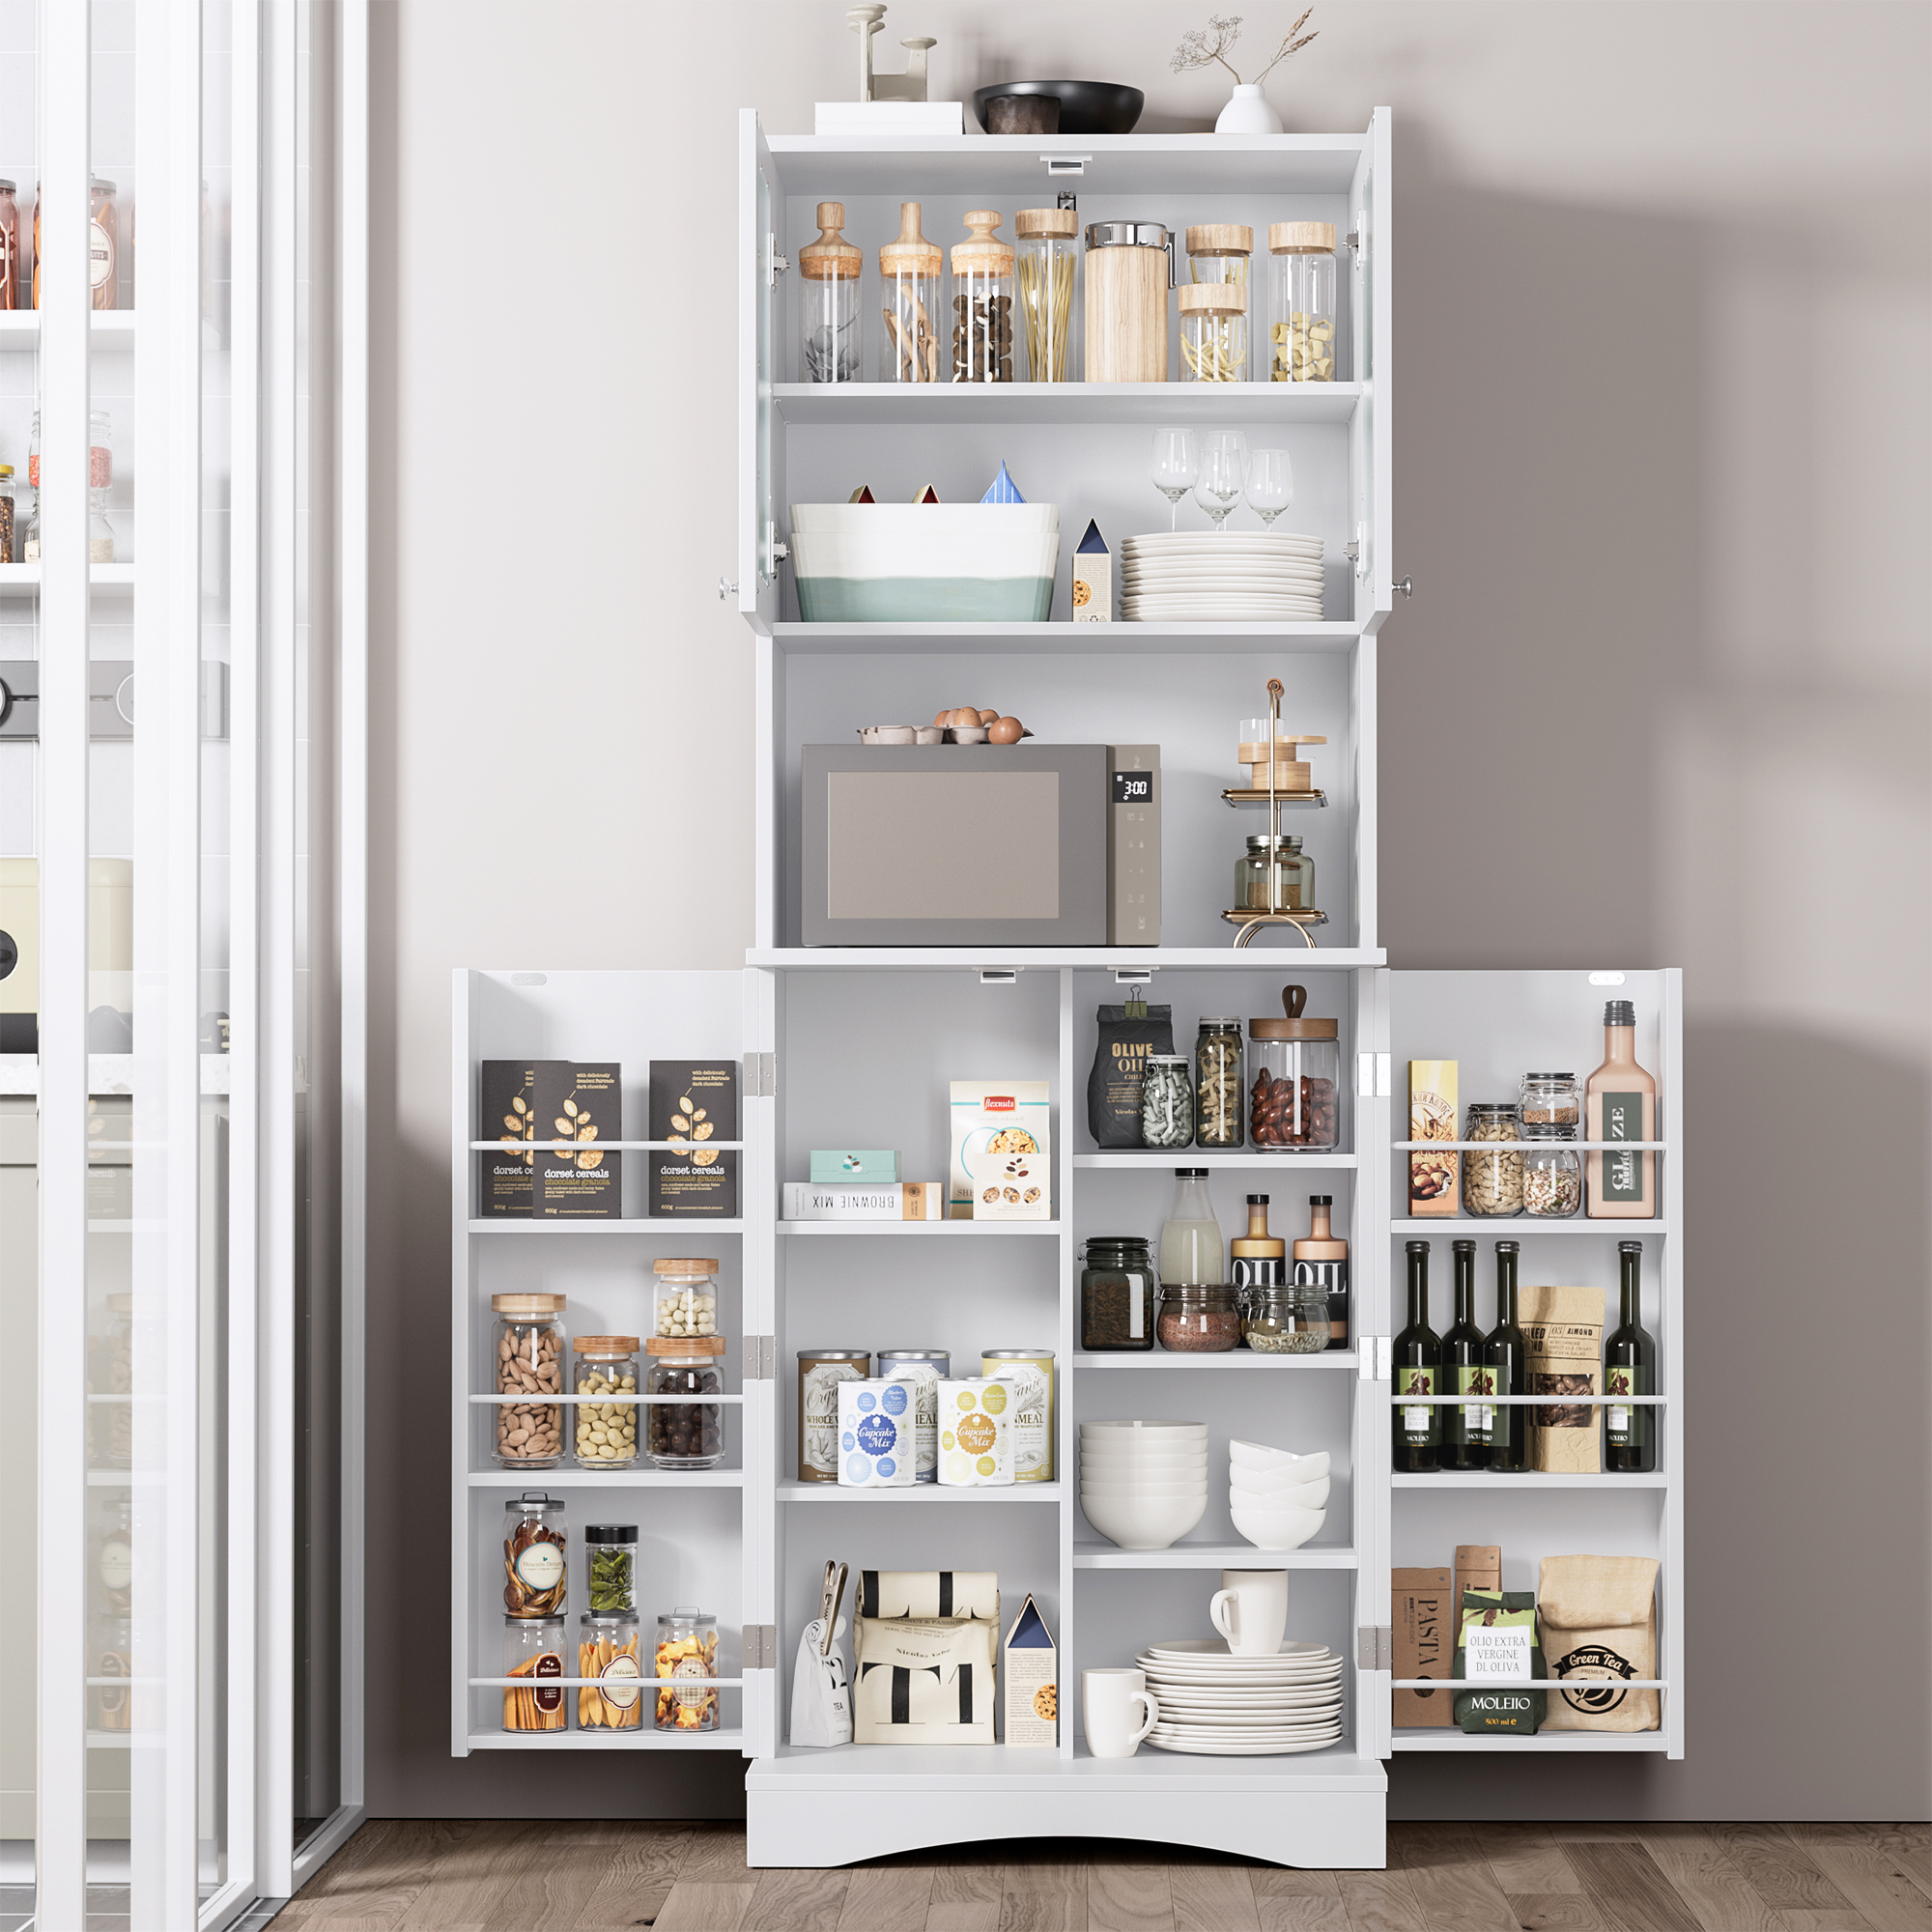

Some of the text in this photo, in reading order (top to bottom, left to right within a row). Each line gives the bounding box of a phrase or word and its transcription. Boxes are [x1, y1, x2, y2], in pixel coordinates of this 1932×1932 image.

[1125, 781, 1147, 795] 3:00
[1112, 1042, 1153, 1057] OLIVE
[1118, 1059, 1146, 1072] OIL
[984, 1098, 1014, 1109] flexnuts
[494, 1166, 523, 1175] dorset
[545, 1169, 610, 1179] dorset cereals
[661, 1166, 724, 1175] dorset cereals
[582, 1178, 611, 1186] granola
[661, 1174, 725, 1183] chocolate granola
[812, 1196, 895, 1208] BROWNIE MIX
[1294, 1262, 1347, 1293] OIL
[1567, 1327, 1593, 1336] ALMOND
[807, 1414, 834, 1424] WHOLE
[858, 1427, 895, 1439] Cupcake
[958, 1426, 994, 1438] Cupcake
[868, 1436, 891, 1447] Mix
[968, 1435, 990, 1447] Mix
[1418, 1598, 1439, 1666] PASTA
[1470, 1636, 1525, 1646] OLIO EXTRA
[896, 1648, 928, 1658] Nicolas
[1477, 1649, 1519, 1660] VERGINE
[1491, 1662, 1520, 1671] OLIVA
[1569, 1653, 1623, 1670] Green Tea
[834, 1702, 843, 1711] TEA
